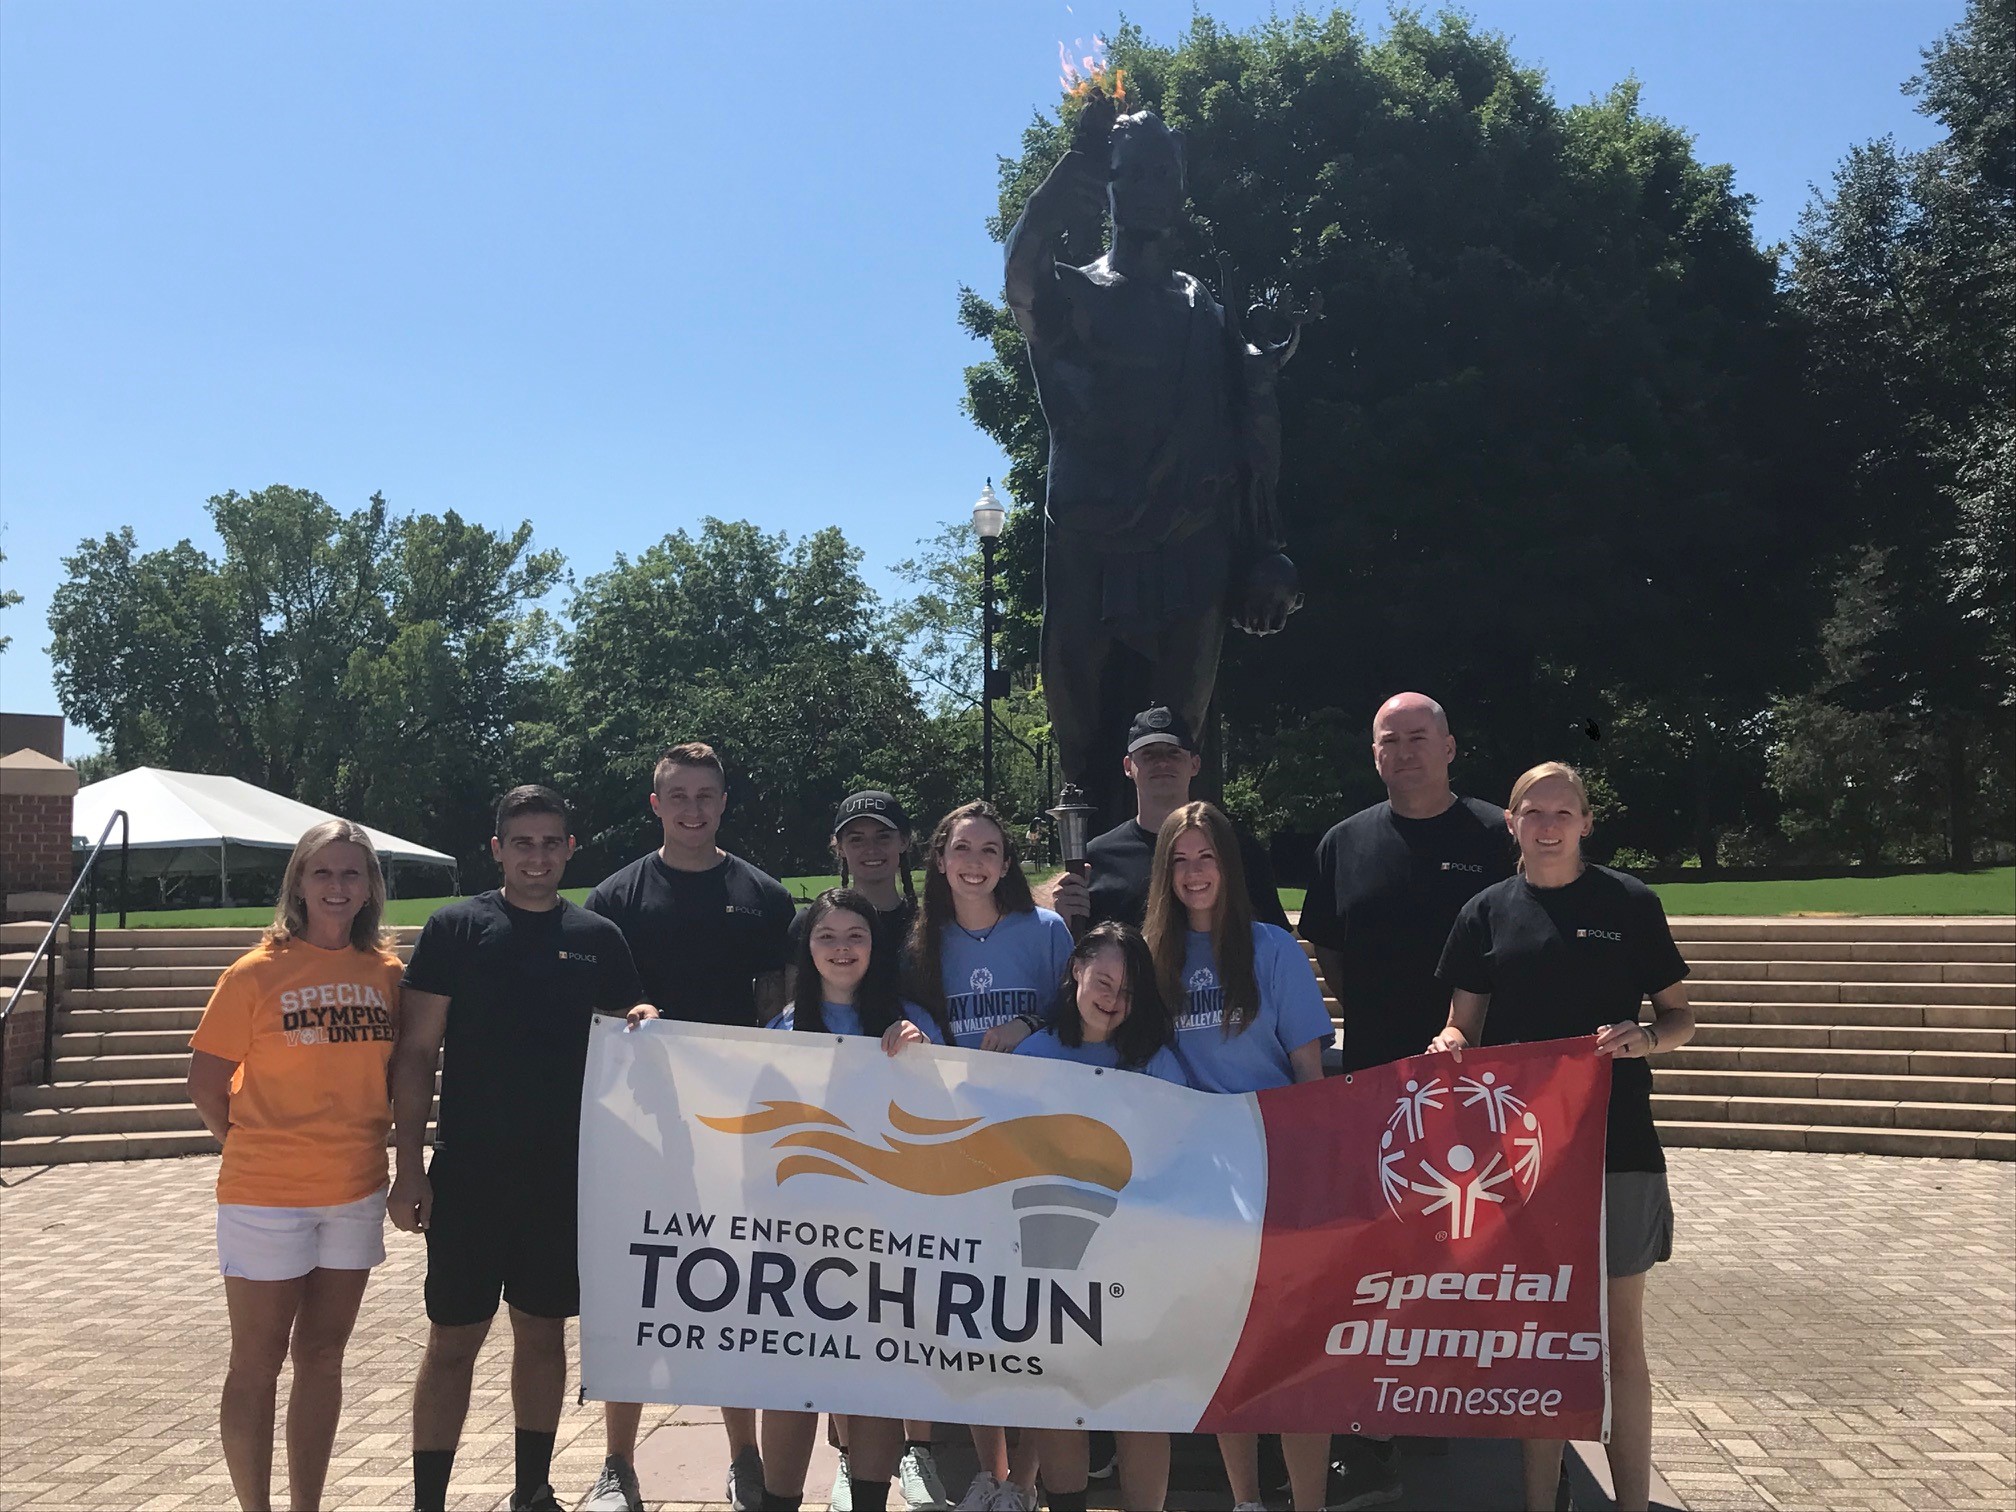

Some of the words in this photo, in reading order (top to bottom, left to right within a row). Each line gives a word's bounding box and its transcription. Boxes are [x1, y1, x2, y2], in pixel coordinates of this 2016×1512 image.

[1451, 862, 1483, 873] POLICE
[735, 906, 763, 917] POLICE
[1588, 929, 1622, 941] POLICE
[569, 952, 598, 963] POLICE
[973, 990, 1037, 1018] UNIFIED
[283, 1006, 391, 1031] OLYMPIC
[964, 1015, 996, 1033] VALLEY
[284, 1026, 394, 1047] VOLUNTEE
[643, 1210, 716, 1238] LAW
[730, 1216, 982, 1263] ENFORCEMENT
[629, 1243, 917, 1329] TORCH
[1352, 1264, 1574, 1310] Special
[636, 1322, 706, 1350] FOR
[718, 1327, 861, 1360] SPECIAL
[875, 1338, 1044, 1376] OLYMPICS
[1325, 1319, 1602, 1368] Olympics
[1373, 1377, 1563, 1416] Tennessee
